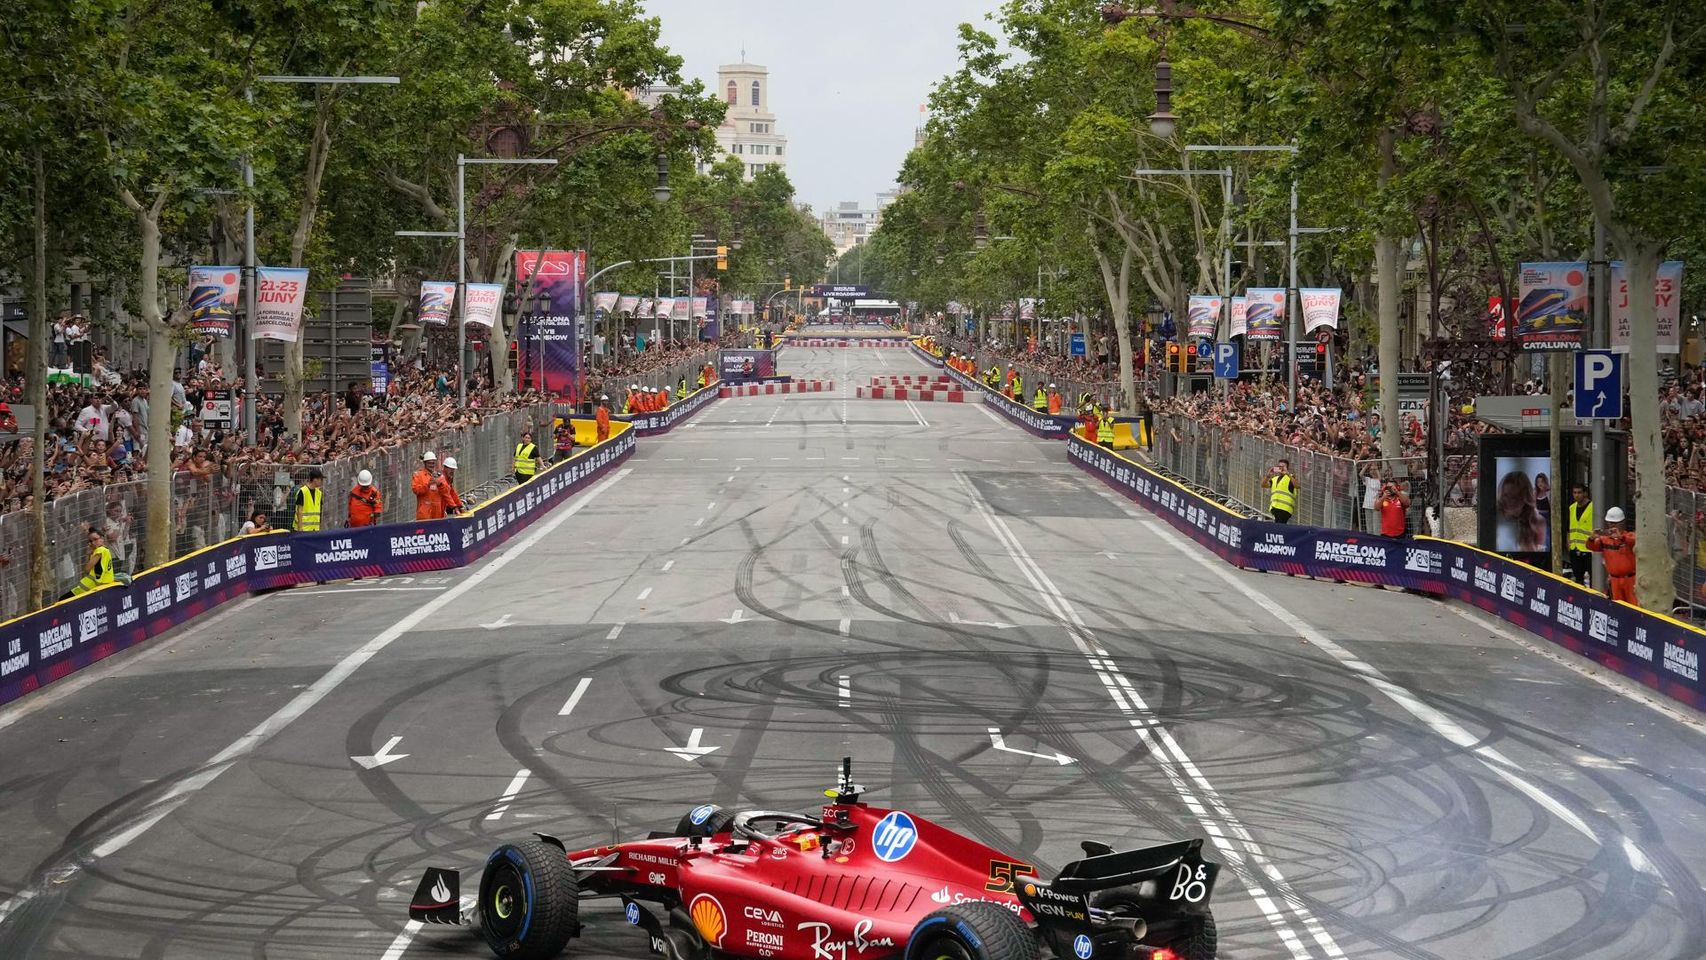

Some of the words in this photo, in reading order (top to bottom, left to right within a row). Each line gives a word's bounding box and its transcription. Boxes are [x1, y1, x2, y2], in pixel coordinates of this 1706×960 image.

[260, 280, 299, 292] 21-23
[258, 292, 298, 304] JUNY
[1218, 344, 1234, 364] P
[1523, 342, 1582, 350] CATALUNYA
[1584, 354, 1613, 391] P
[331, 539, 353, 550] LIVE
[390, 533, 450, 549] BARCELONA
[1265, 533, 1285, 544] LIVE
[315, 549, 369, 564] ROADSHOW
[434, 544, 451, 552] 2024
[1253, 542, 1297, 556] ROADSHOW
[1316, 541, 1387, 560] BARCELONA
[1315, 551, 1330, 561] FAN
[1330, 553, 1365, 565] FESTIVAL
[1365, 557, 1387, 567] 2024
[39, 622, 73, 649] BARCELONA
[1635, 626, 1647, 643] LIVE
[8, 638, 21, 656] LIVE
[1, 651, 30, 677] ROADSHOW
[1664, 641, 1698, 671] BARCELONA
[876, 812, 916, 862] hp
[628, 851, 657, 863] RICHARD
[657, 856, 679, 867] MILLE
[1036, 888, 1080, 904] V-Power
[628, 903, 638, 924] hp
[1030, 902, 1066, 917] VGW
[1065, 911, 1086, 921] PLAY
[761, 921, 785, 929] LOGISTICS
[746, 929, 784, 946] PERONI
[797, 919, 895, 960] Ray-Ban
[1077, 938, 1090, 959] hp
